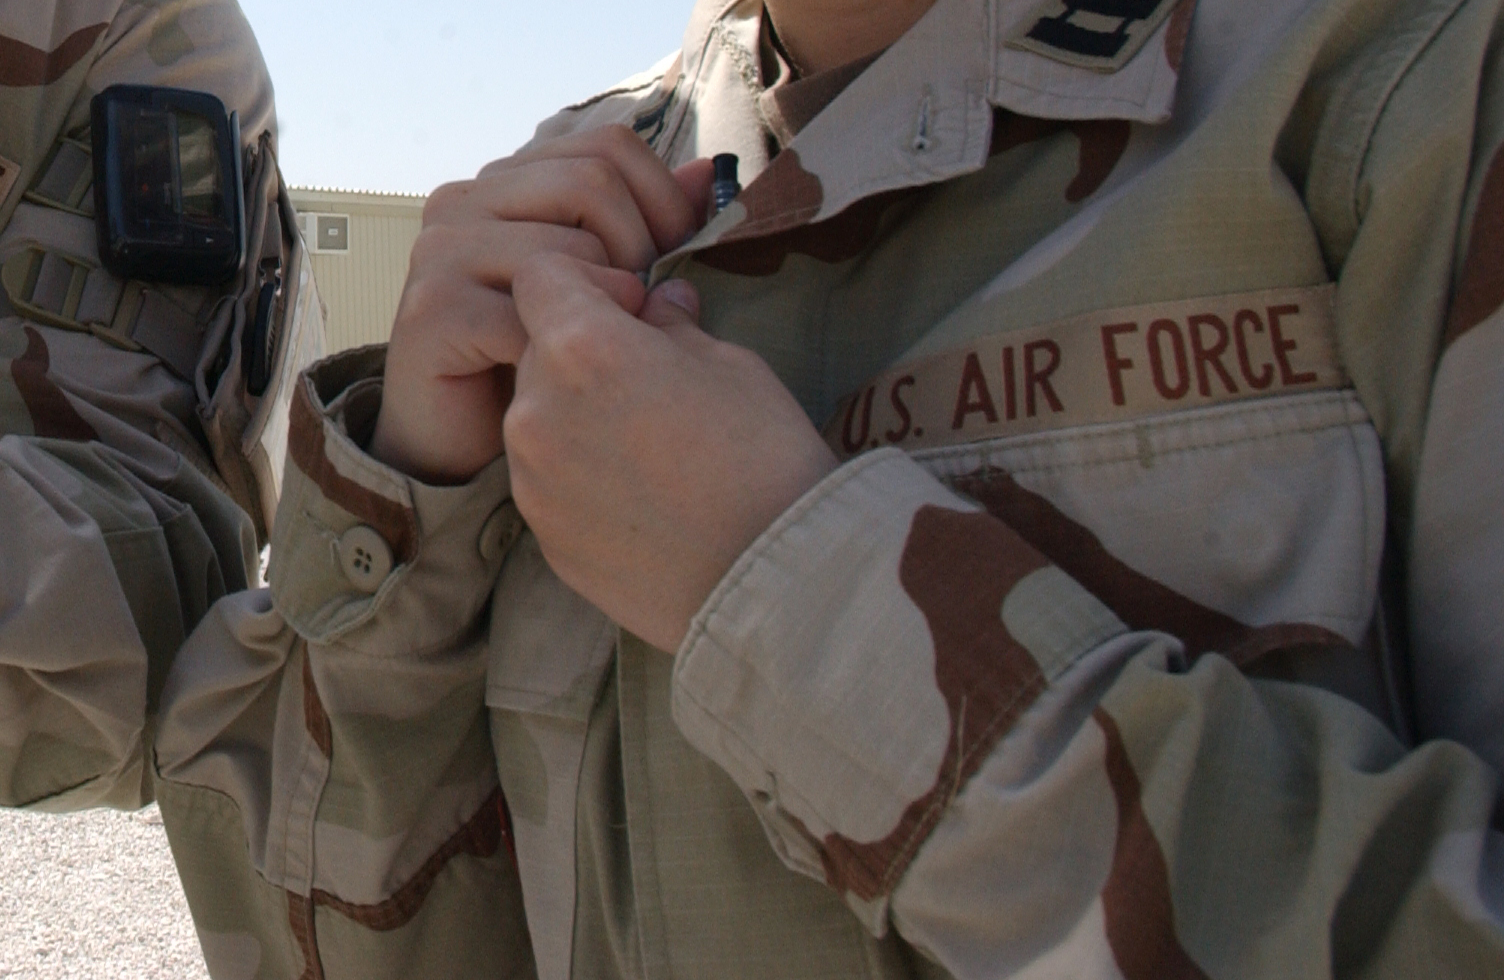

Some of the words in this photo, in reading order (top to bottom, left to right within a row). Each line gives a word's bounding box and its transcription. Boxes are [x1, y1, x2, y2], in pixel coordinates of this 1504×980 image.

[841, 375, 924, 453] U.S.
[951, 338, 1065, 430] AIR
[1101, 304, 1318, 407] FORCE
